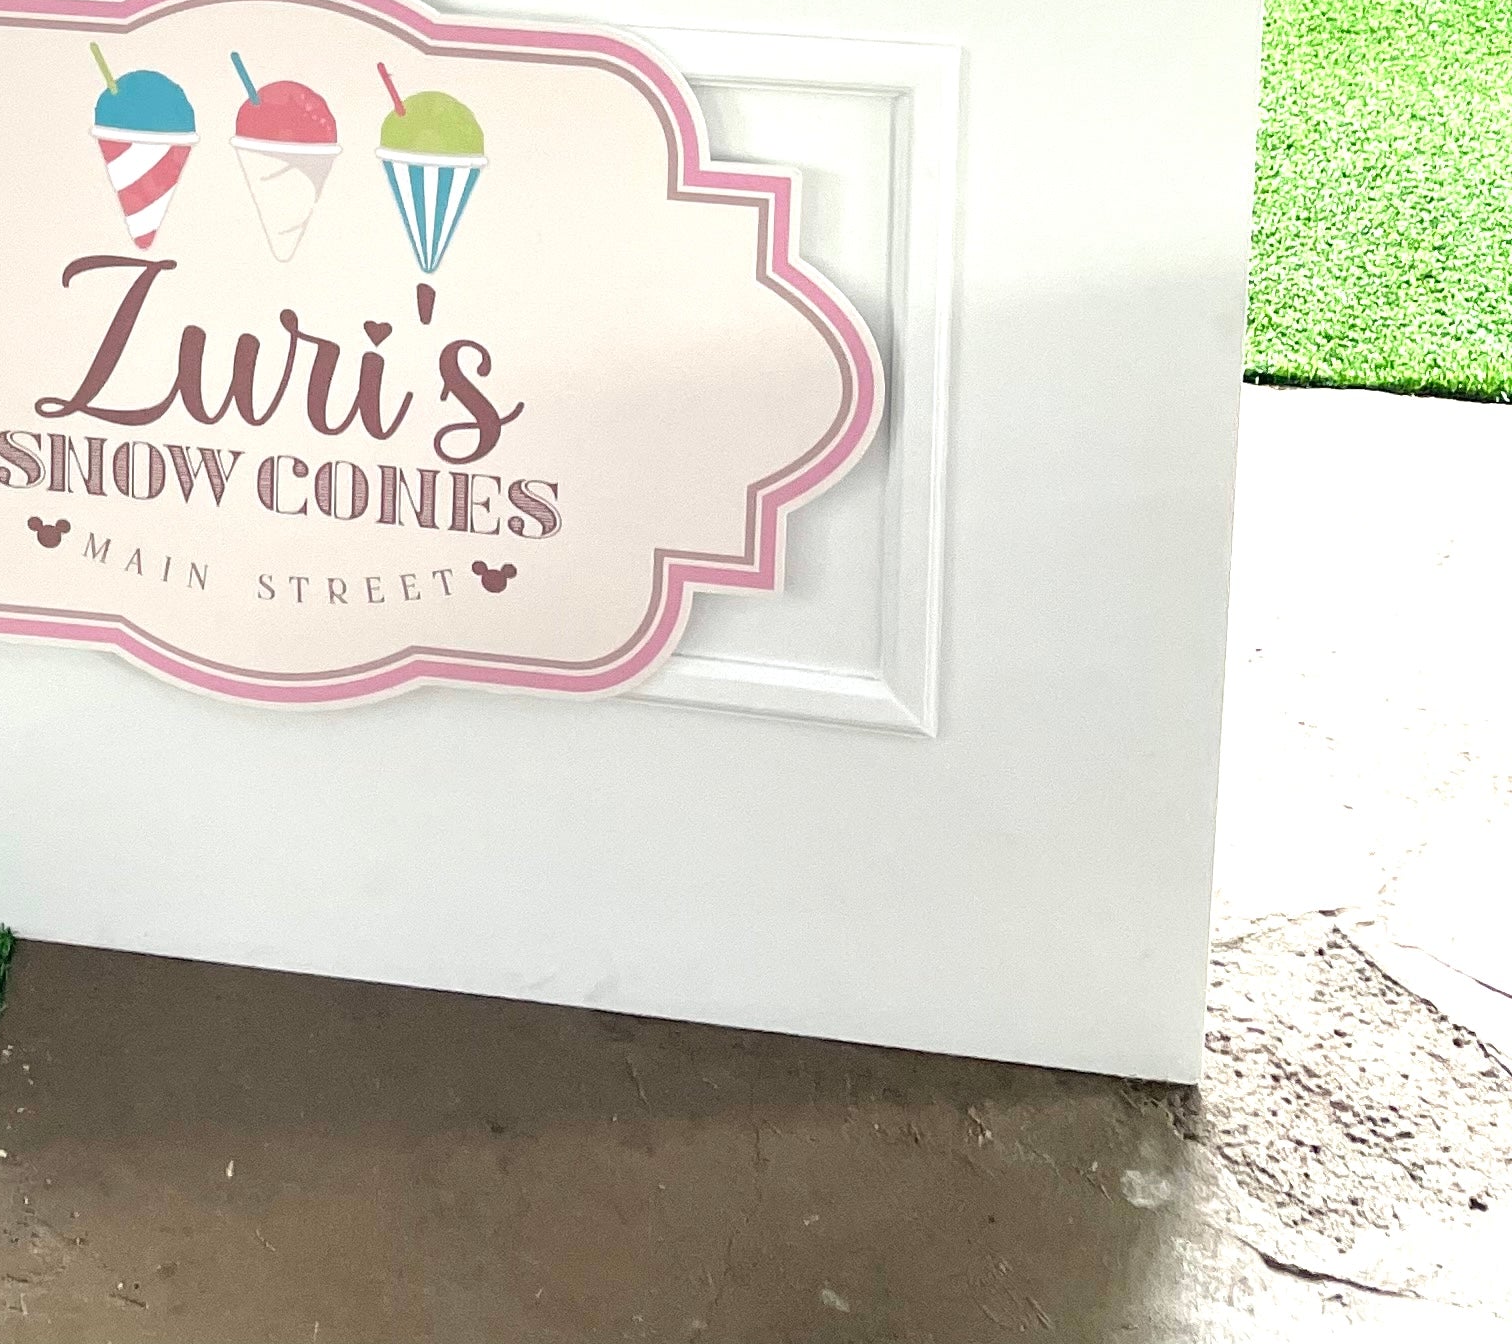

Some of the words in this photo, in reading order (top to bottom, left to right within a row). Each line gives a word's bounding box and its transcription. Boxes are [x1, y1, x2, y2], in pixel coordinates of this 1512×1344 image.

[34, 255, 525, 465] Zuri's
[256, 454, 564, 540] CONES
[82, 532, 210, 591] MAIN
[256, 568, 456, 605] STREET
